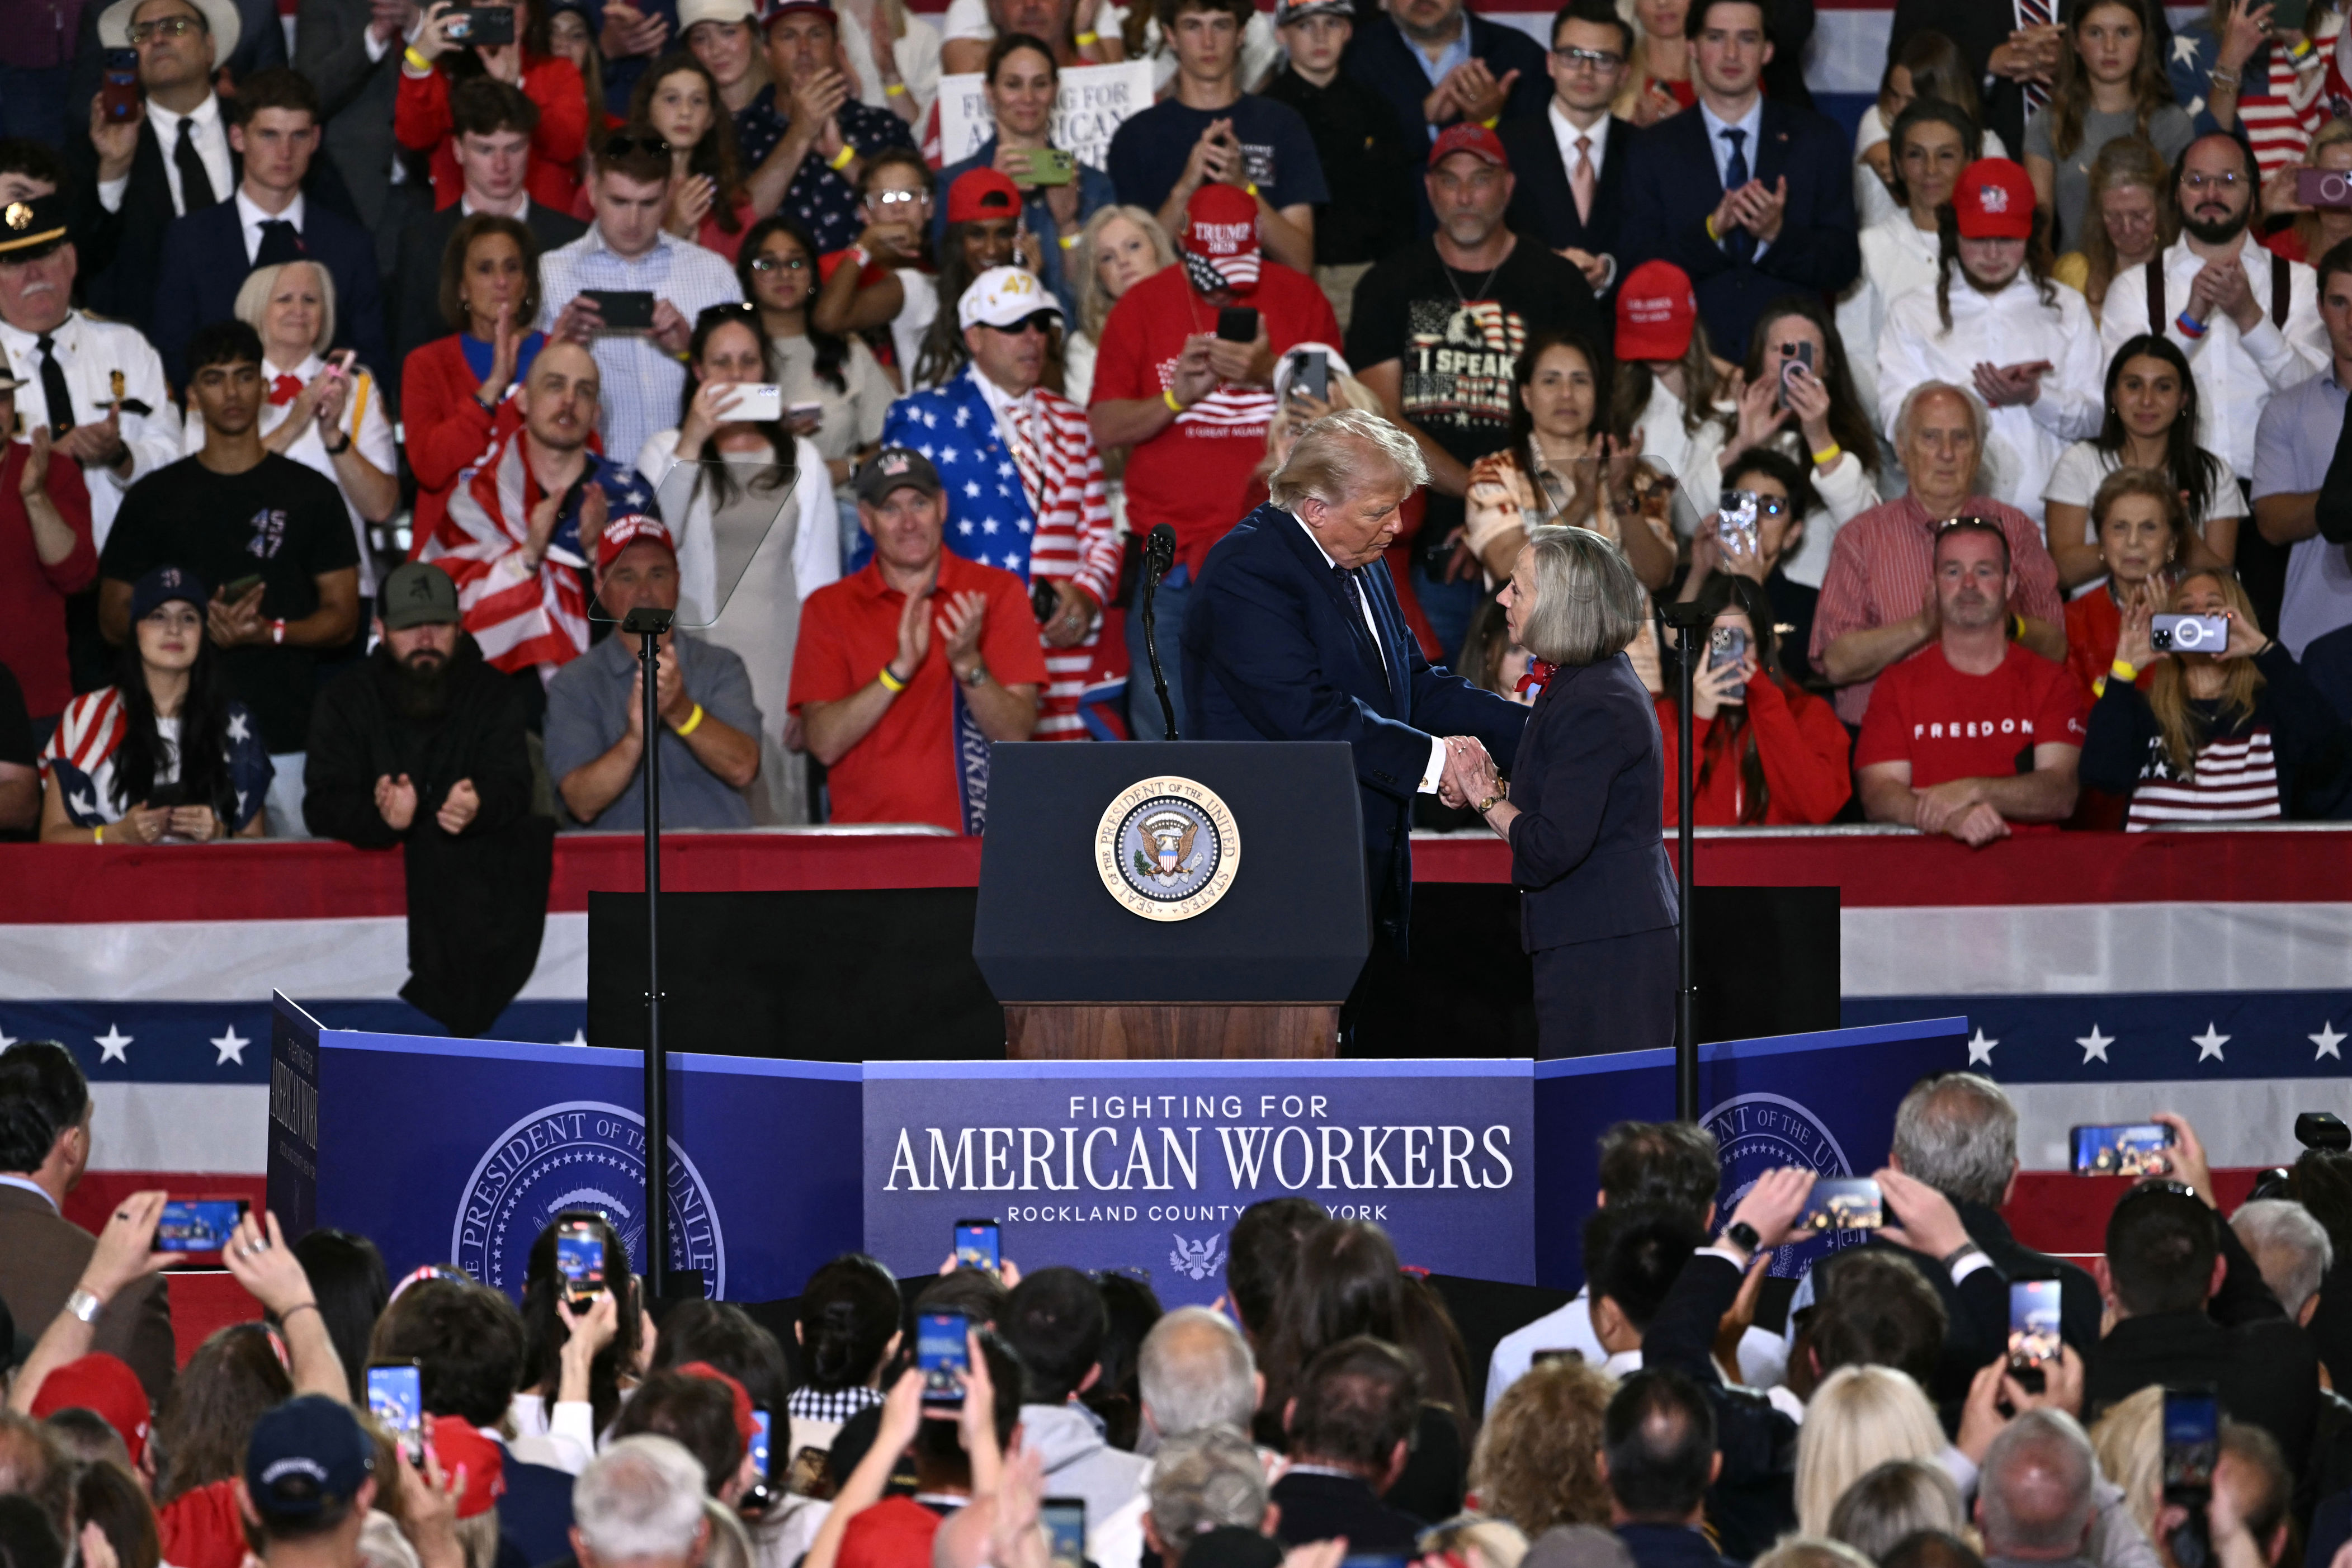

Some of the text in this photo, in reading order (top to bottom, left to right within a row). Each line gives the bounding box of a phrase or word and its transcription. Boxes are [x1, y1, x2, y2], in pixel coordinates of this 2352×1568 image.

[1193, 221, 1251, 241] TRUMP
[1002, 275, 1032, 294] 47
[1419, 347, 1518, 381] I SPEAK
[1196, 426, 1229, 438] GREAT
[1231, 425, 1265, 438] AGAIN
[250, 508, 287, 532] 45
[245, 534, 283, 558] 47
[1101, 782, 1235, 914] SEAL OF THE PRESIDENT OF THE UNITED STATES
[271, 1056, 318, 1151] AMERICAN WORK
[1070, 1095, 1328, 1118] FIGHTING FOR
[1758, 1109, 1778, 1127] OF
[1782, 1114, 1811, 1145] THE
[883, 1125, 1513, 1191] AMERICAN WORKERS
[462, 1113, 714, 1300] PRESIDENT OF TH UNITED
[1008, 1206, 1387, 1222] ROCKLAND COUNTY YORK
